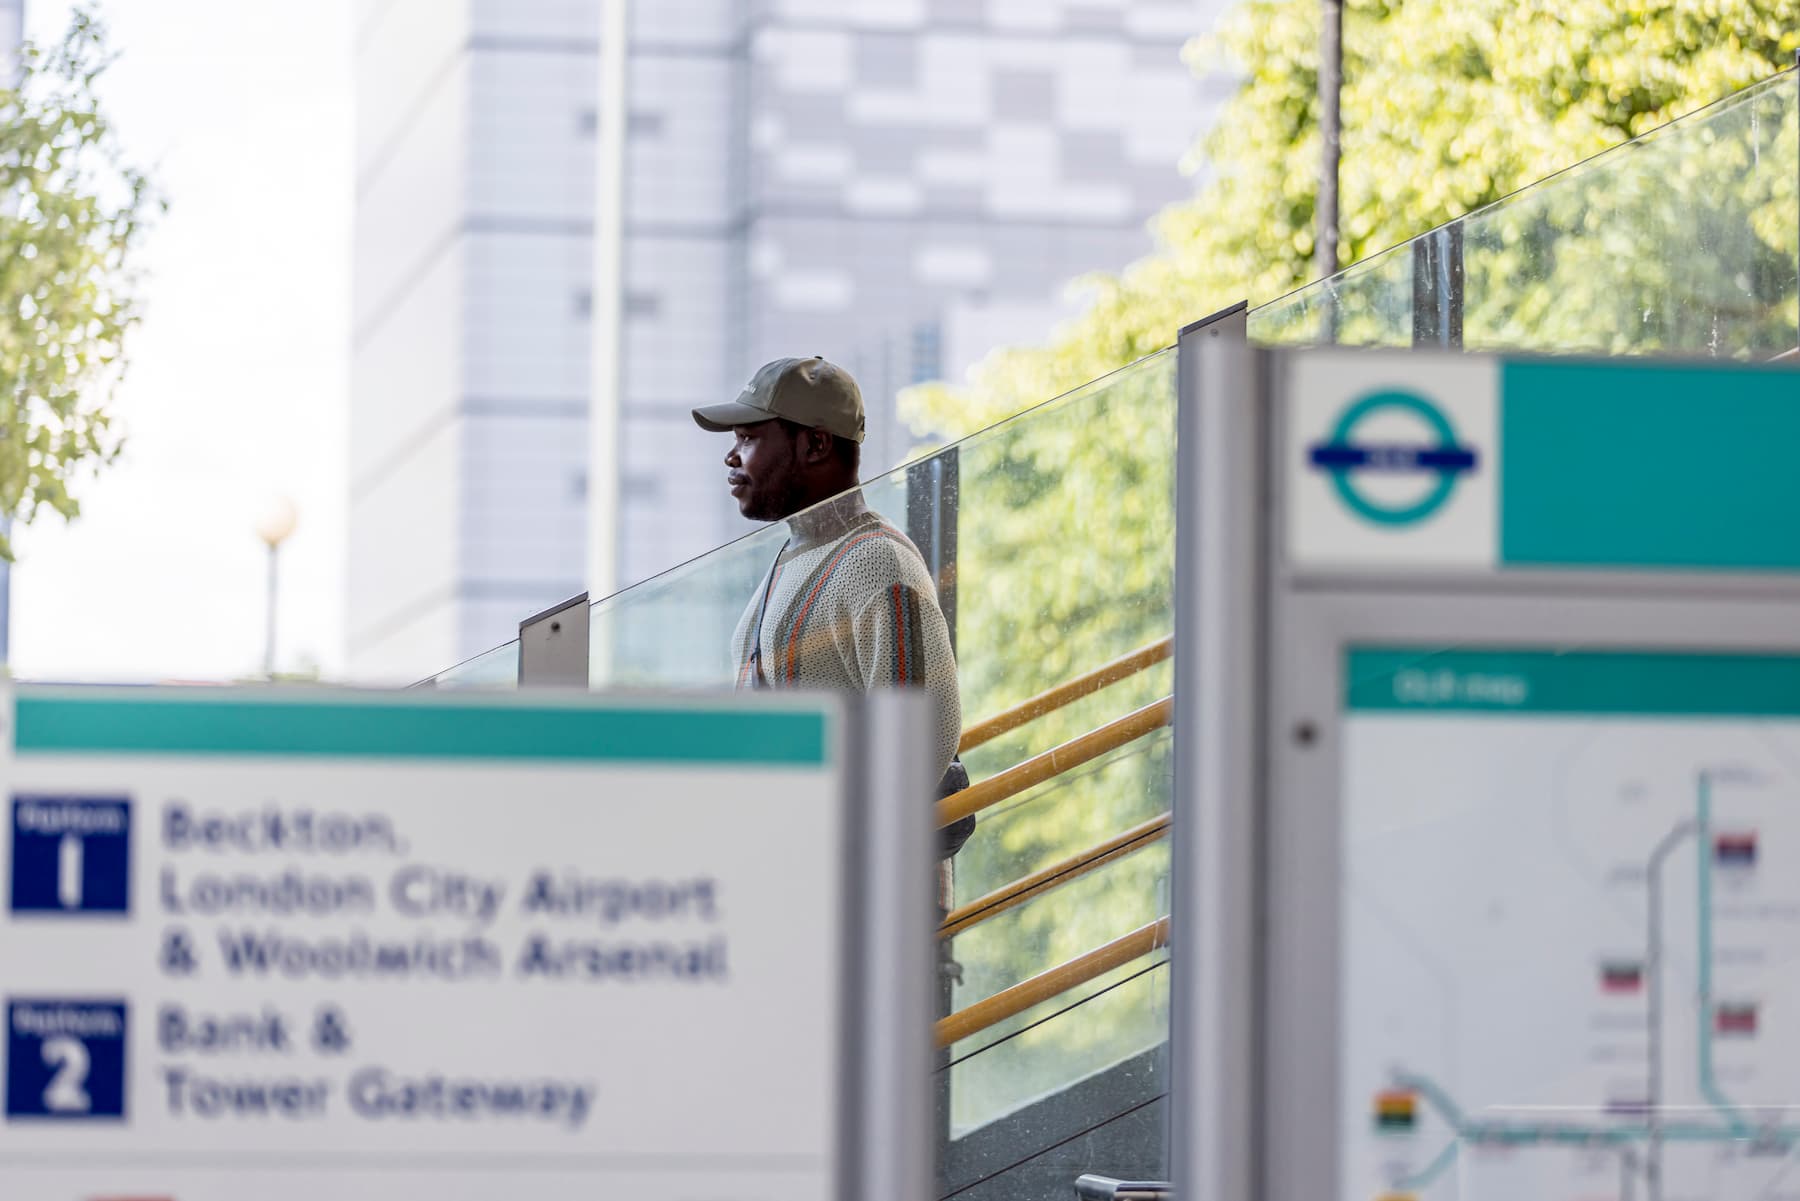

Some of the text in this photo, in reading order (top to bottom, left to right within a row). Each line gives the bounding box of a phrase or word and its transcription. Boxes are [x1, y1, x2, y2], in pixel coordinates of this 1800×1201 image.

[58, 836, 84, 909] 1
[161, 864, 718, 922] London City Airport
[161, 927, 728, 980] & Woolwich Arsenal
[161, 1003, 352, 1054] Bank &
[41, 1036, 92, 1111] 2
[161, 1067, 596, 1126] Tower Gateway
